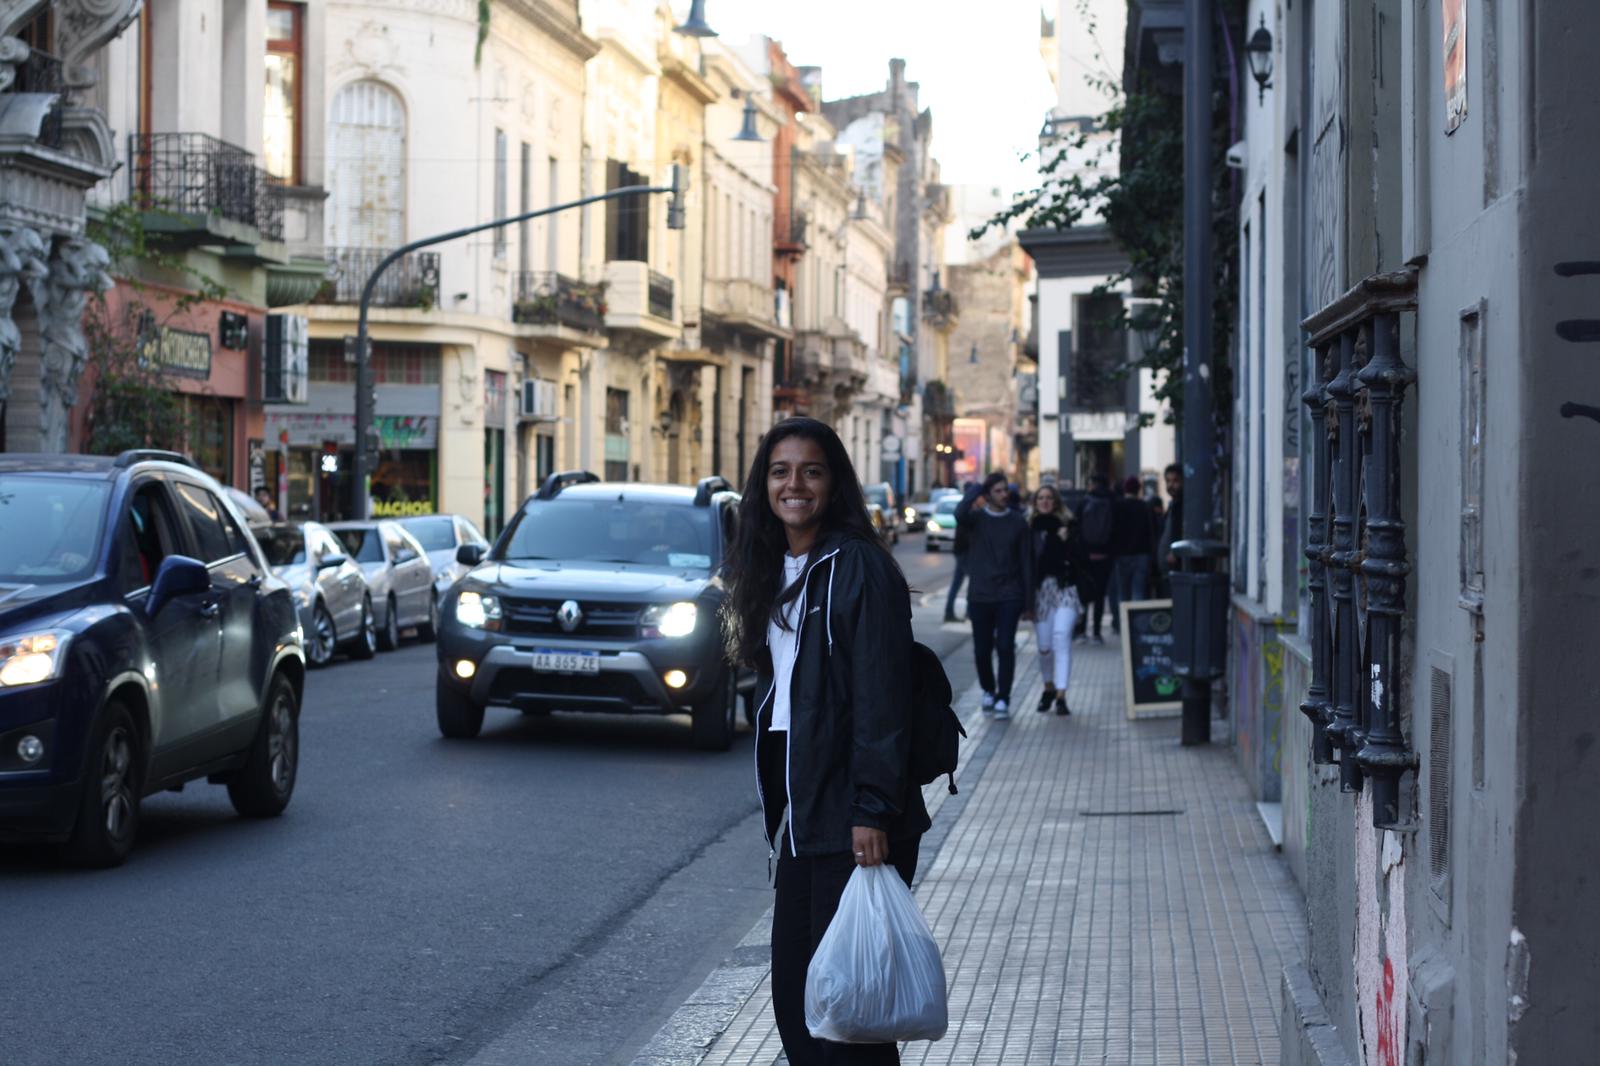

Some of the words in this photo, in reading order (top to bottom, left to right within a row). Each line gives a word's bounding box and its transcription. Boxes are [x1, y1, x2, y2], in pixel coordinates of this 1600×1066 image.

[373, 501, 432, 516] NACHOS
[535, 655, 551, 668] AA
[554, 656, 577, 669] 865
[581, 657, 597, 670] ZE
